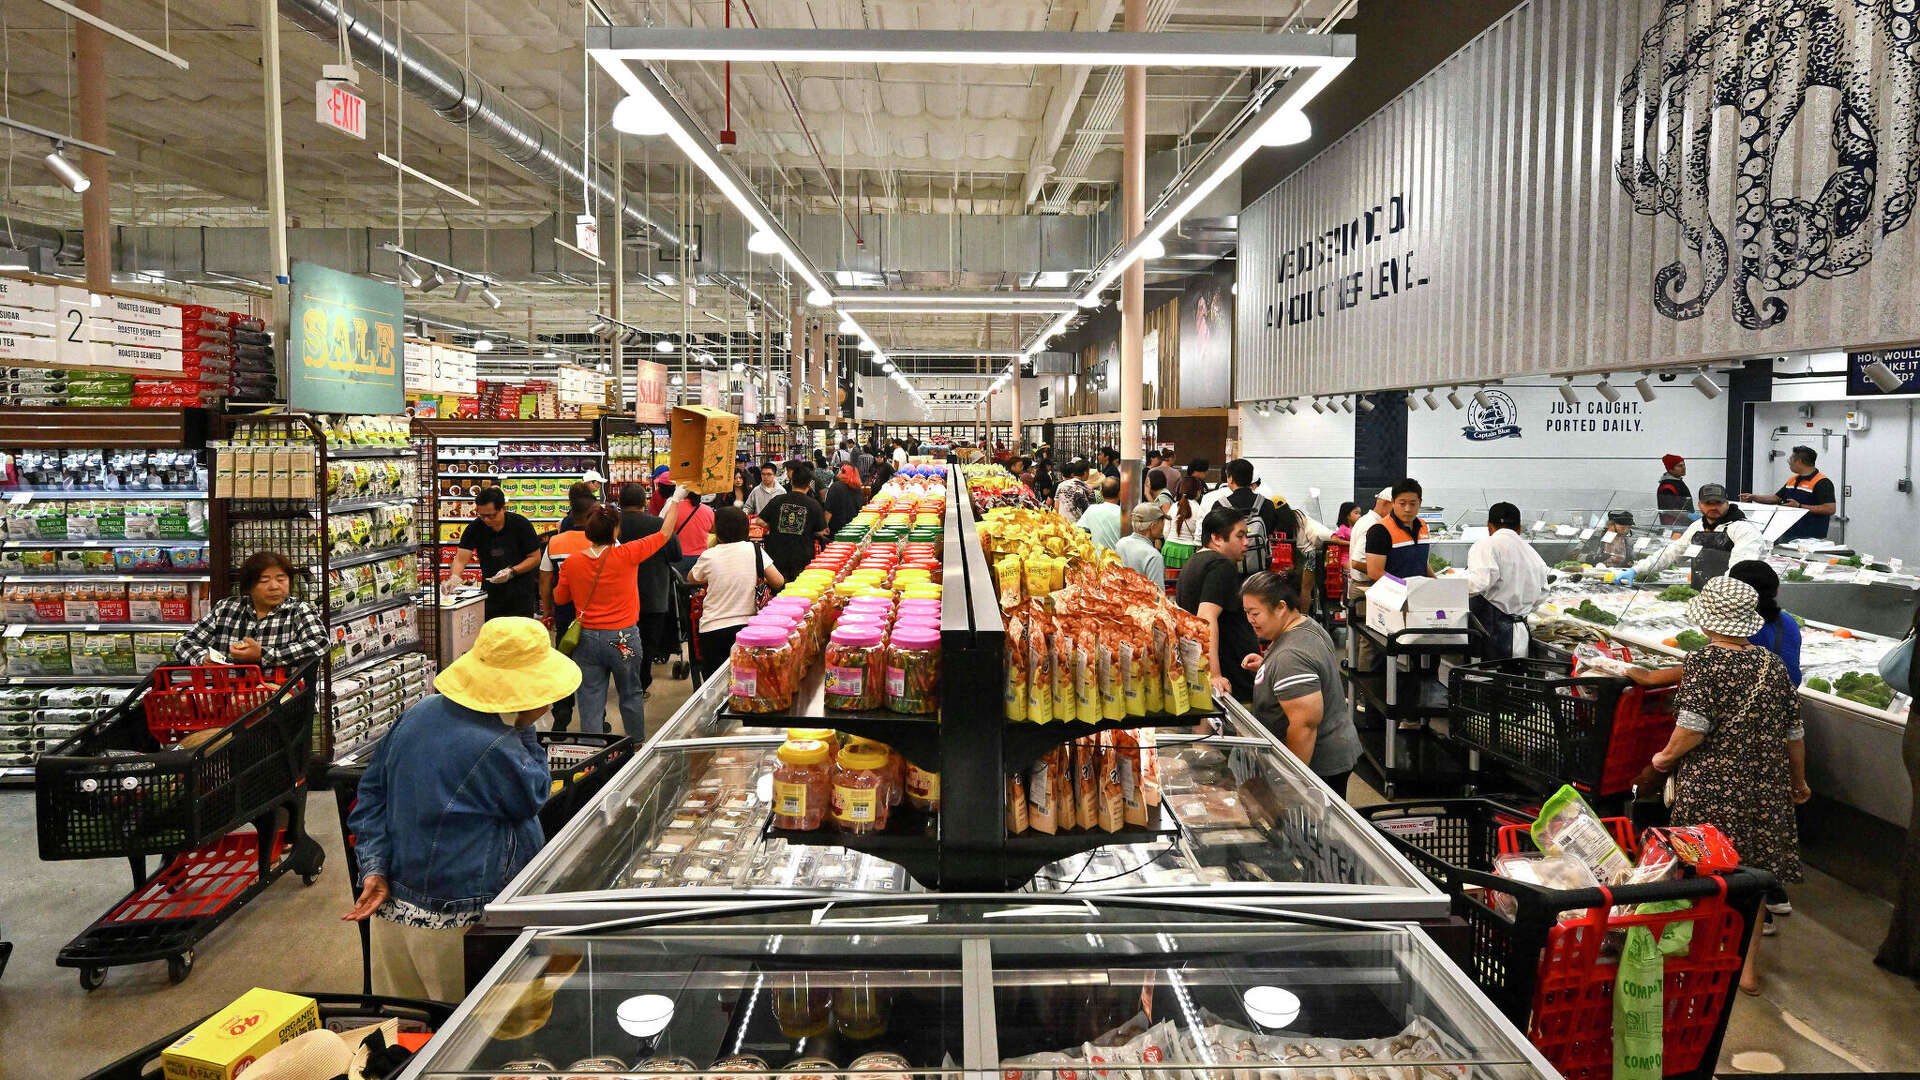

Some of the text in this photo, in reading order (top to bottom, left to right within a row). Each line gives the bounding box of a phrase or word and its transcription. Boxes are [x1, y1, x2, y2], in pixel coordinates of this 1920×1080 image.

[333, 87, 361, 133] EXIT
[0, 310, 20, 320] SUGAR
[117, 301, 161, 316] ROASTED SEAWEED
[67, 309, 83, 343] 2
[117, 325, 161, 338] ROASTED SEAWEED
[3, 337, 15, 347] TEA
[303, 308, 395, 375] SALE
[118, 349, 161, 360] ROASTED SEAWEED
[1884, 350, 1920, 360] WOULD
[434, 358, 441, 378] 3
[1908, 361, 1918, 370] IT
[1550, 401, 1642, 414] JUST CAUGHT.
[1546, 419, 1644, 432] PORTED DAILY.
[1473, 431, 1497, 440] Captain
[278, 1006, 315, 1038] ORGANIC
